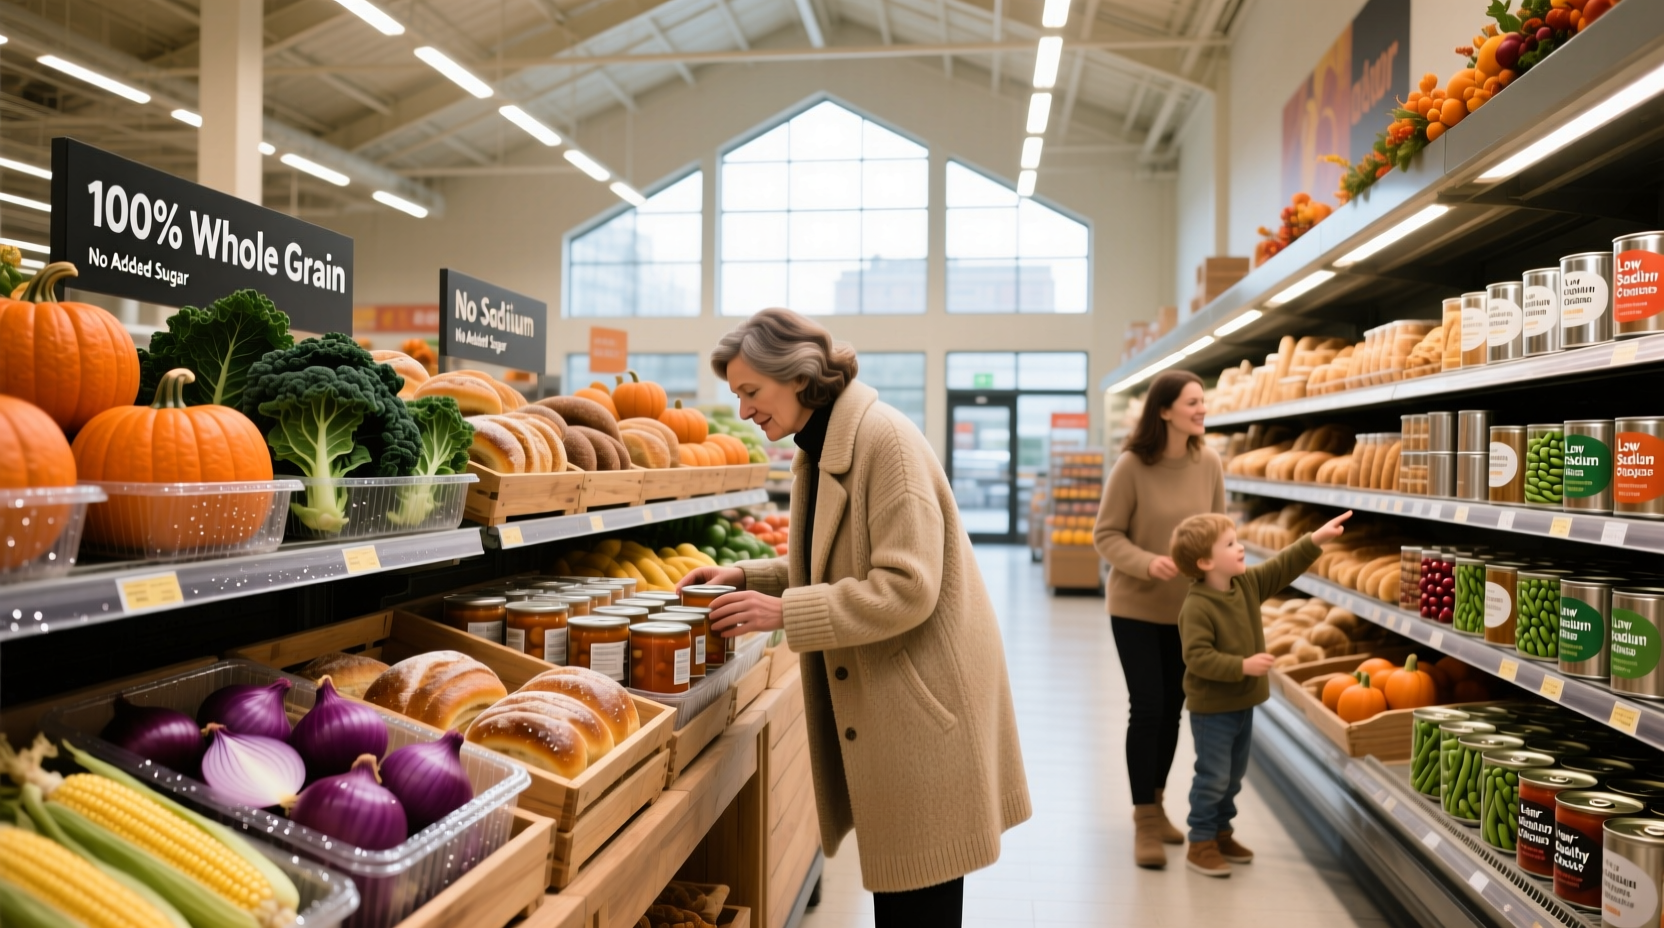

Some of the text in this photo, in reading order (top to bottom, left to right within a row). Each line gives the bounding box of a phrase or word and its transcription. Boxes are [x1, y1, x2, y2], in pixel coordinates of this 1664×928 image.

[88, 180, 345, 294] 100% Whole Grain
[88, 246, 189, 287] No Added Sugar
[455, 289, 477, 323] No
